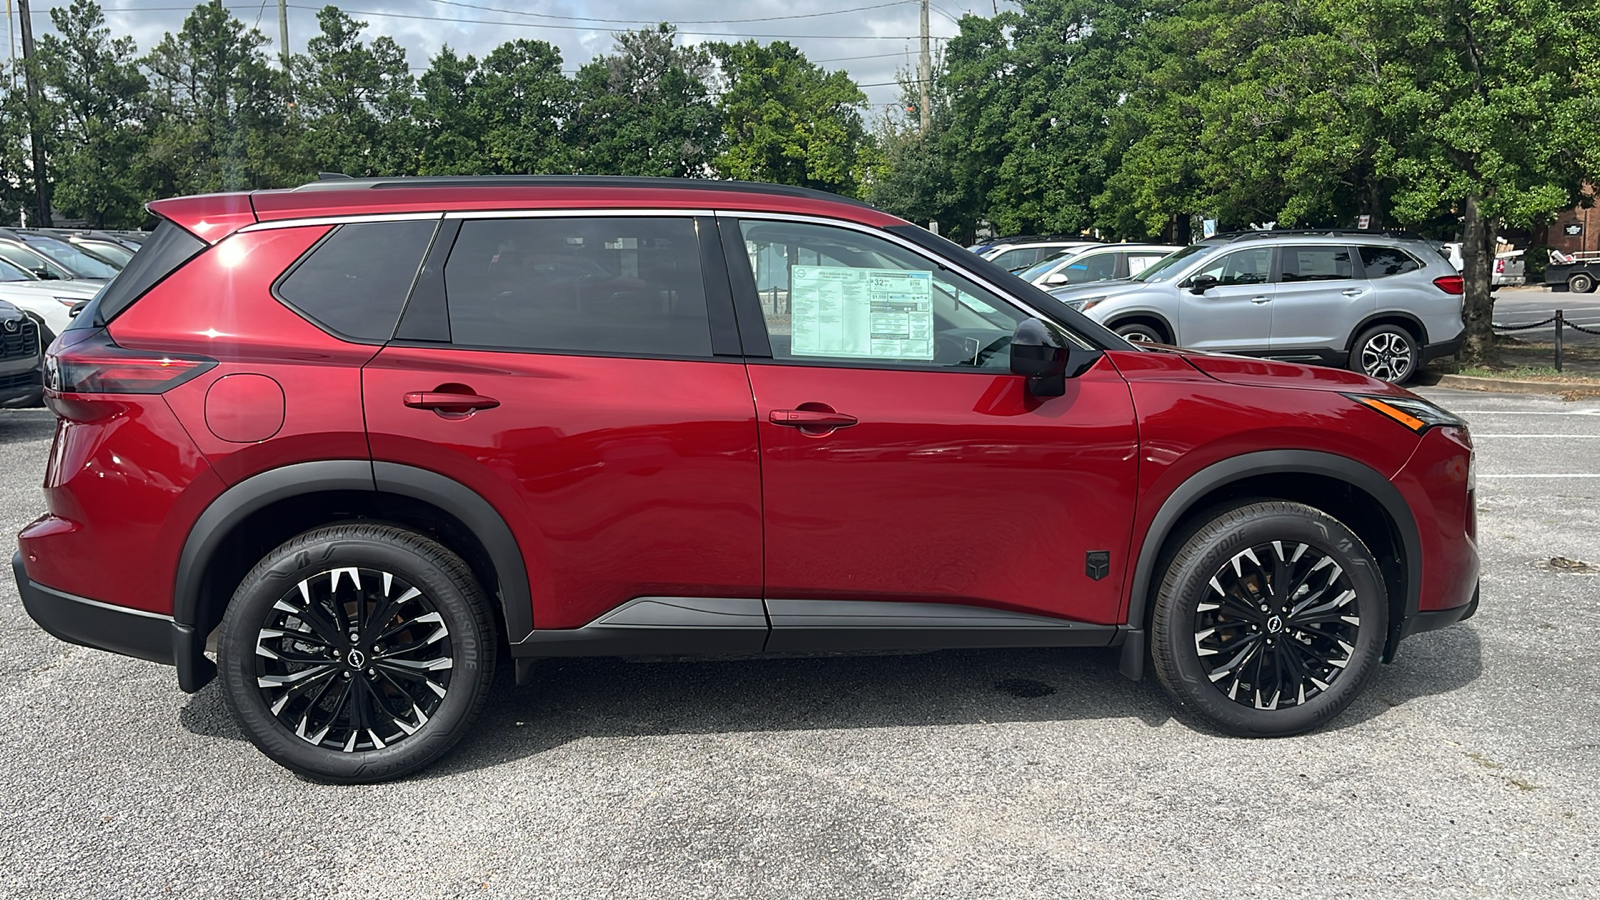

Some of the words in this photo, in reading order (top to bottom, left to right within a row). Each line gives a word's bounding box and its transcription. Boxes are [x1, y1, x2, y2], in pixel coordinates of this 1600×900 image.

[874, 278, 884, 287] 32
[1176, 527, 1246, 616] BRIDGESTONE
[419, 568, 478, 670] BRIDGESTONE
